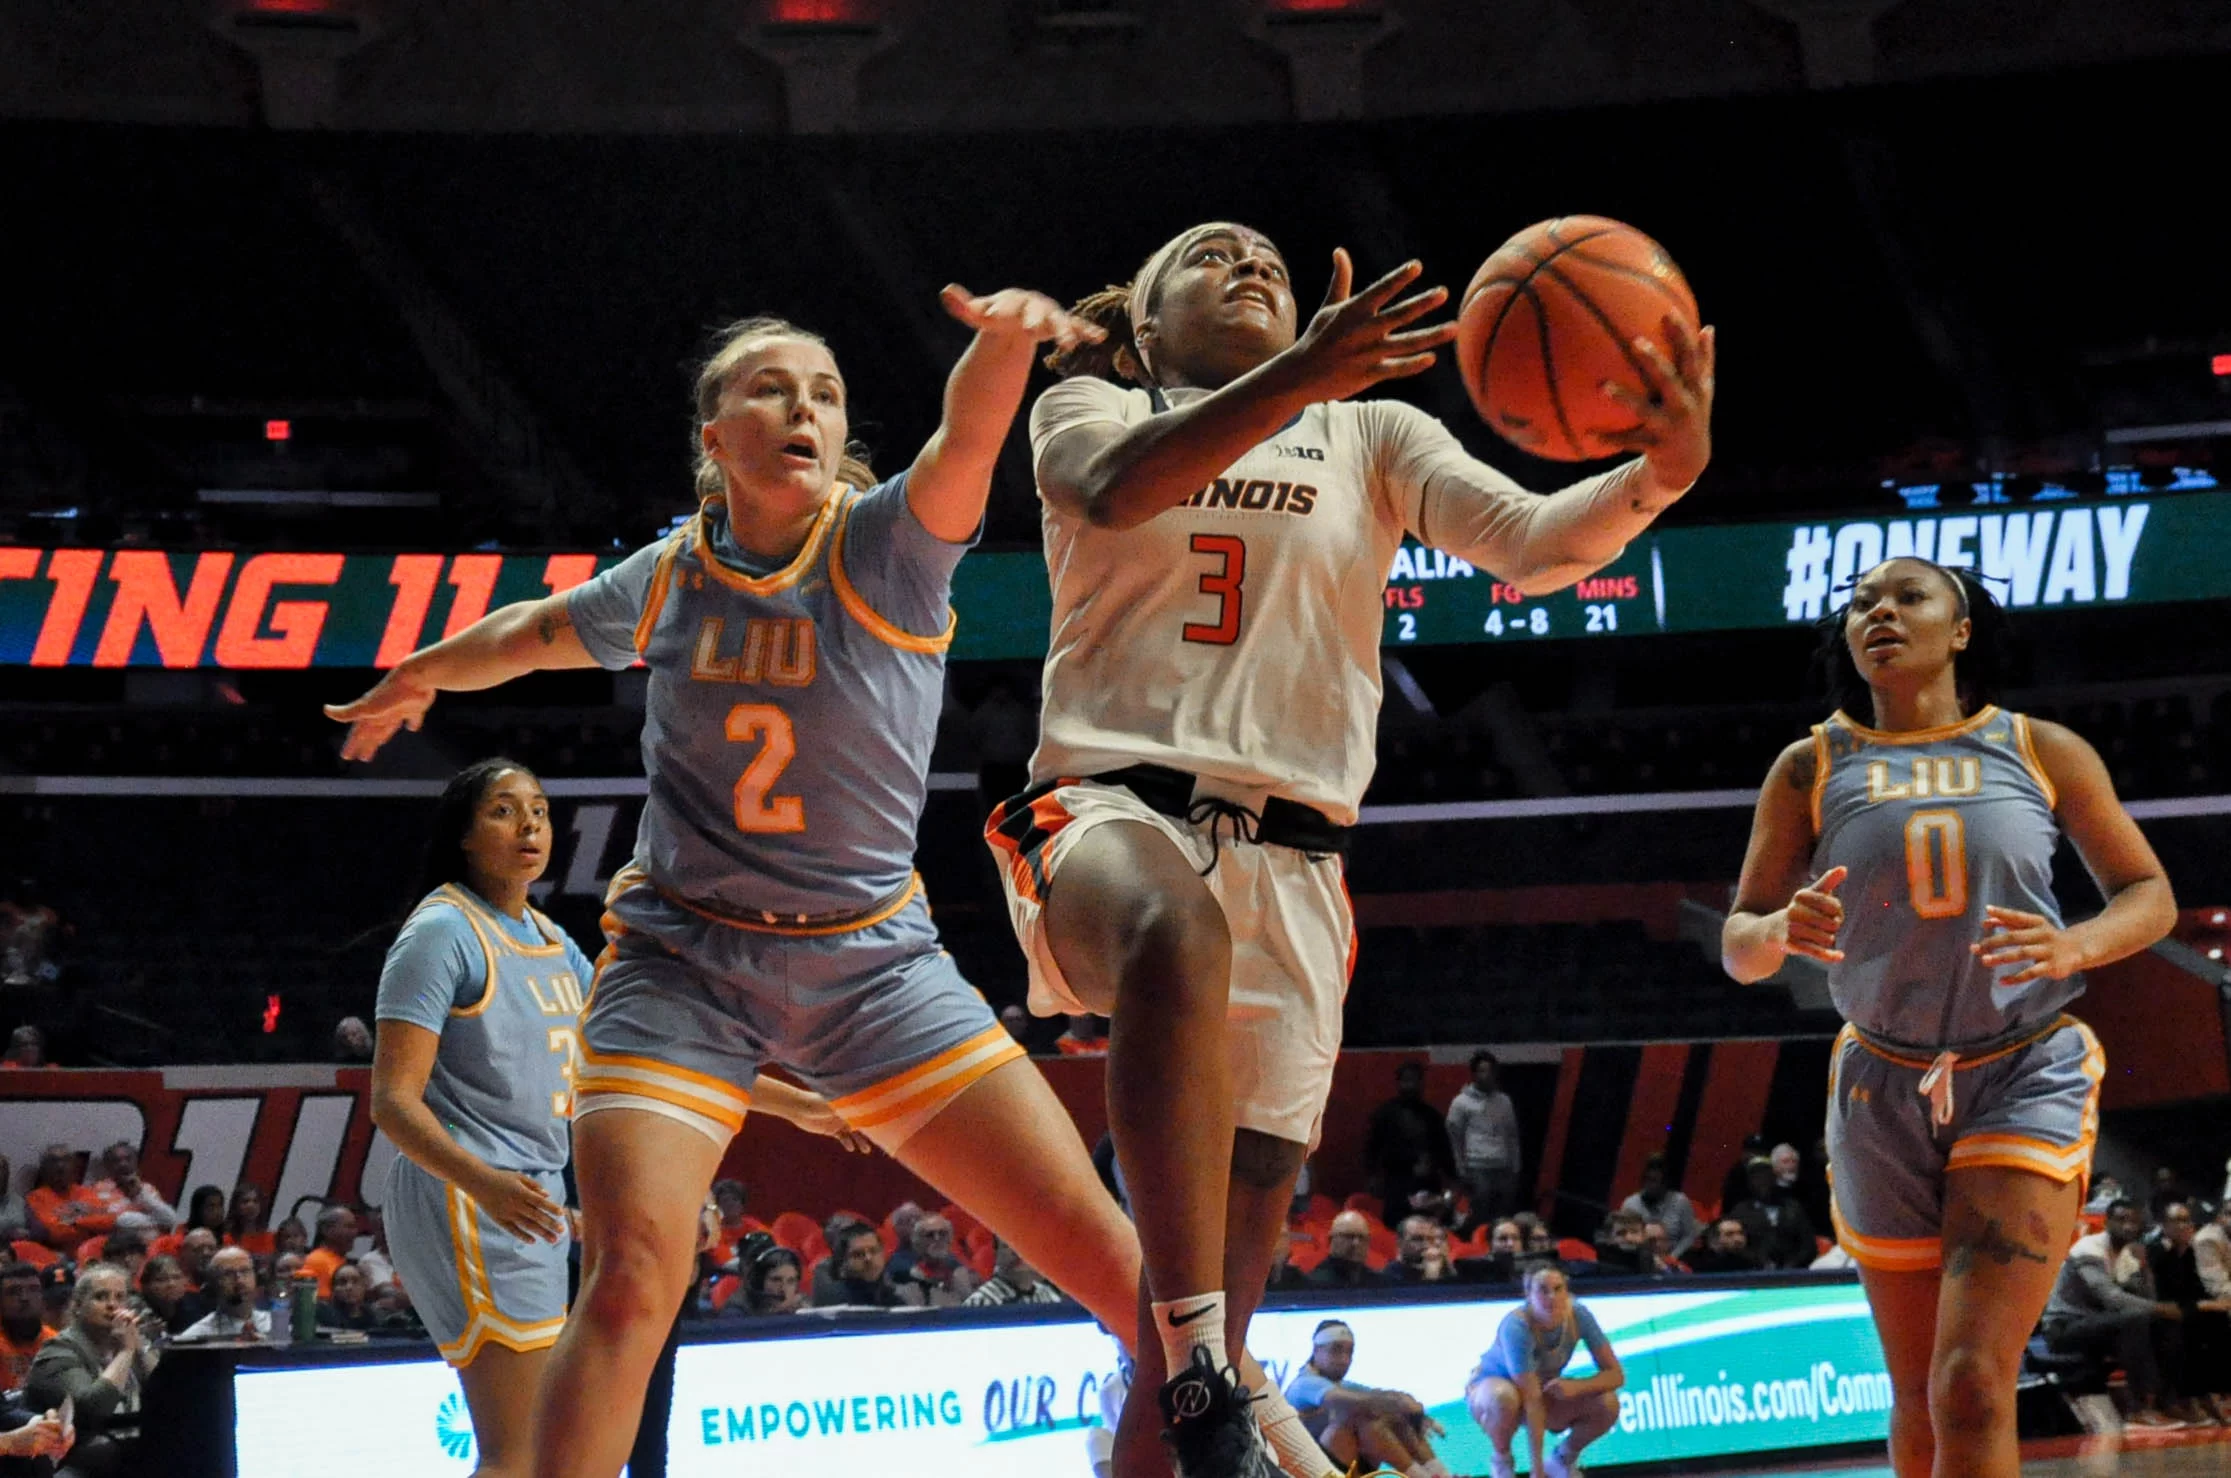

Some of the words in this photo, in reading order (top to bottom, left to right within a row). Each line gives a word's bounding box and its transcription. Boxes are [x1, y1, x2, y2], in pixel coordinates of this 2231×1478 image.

[1182, 534, 1246, 647] 3
[1385, 586, 1425, 609] FLS
[1577, 576, 1639, 601] MINS
[1399, 613, 1417, 641] 2
[1585, 604, 1618, 632] 21
[690, 616, 818, 689] LIU
[723, 703, 807, 834] 2
[1867, 756, 1982, 803] LIU
[1904, 808, 1969, 920] 0
[700, 1389, 963, 1445] EMPOWERING
[984, 1374, 1056, 1432] OUR
